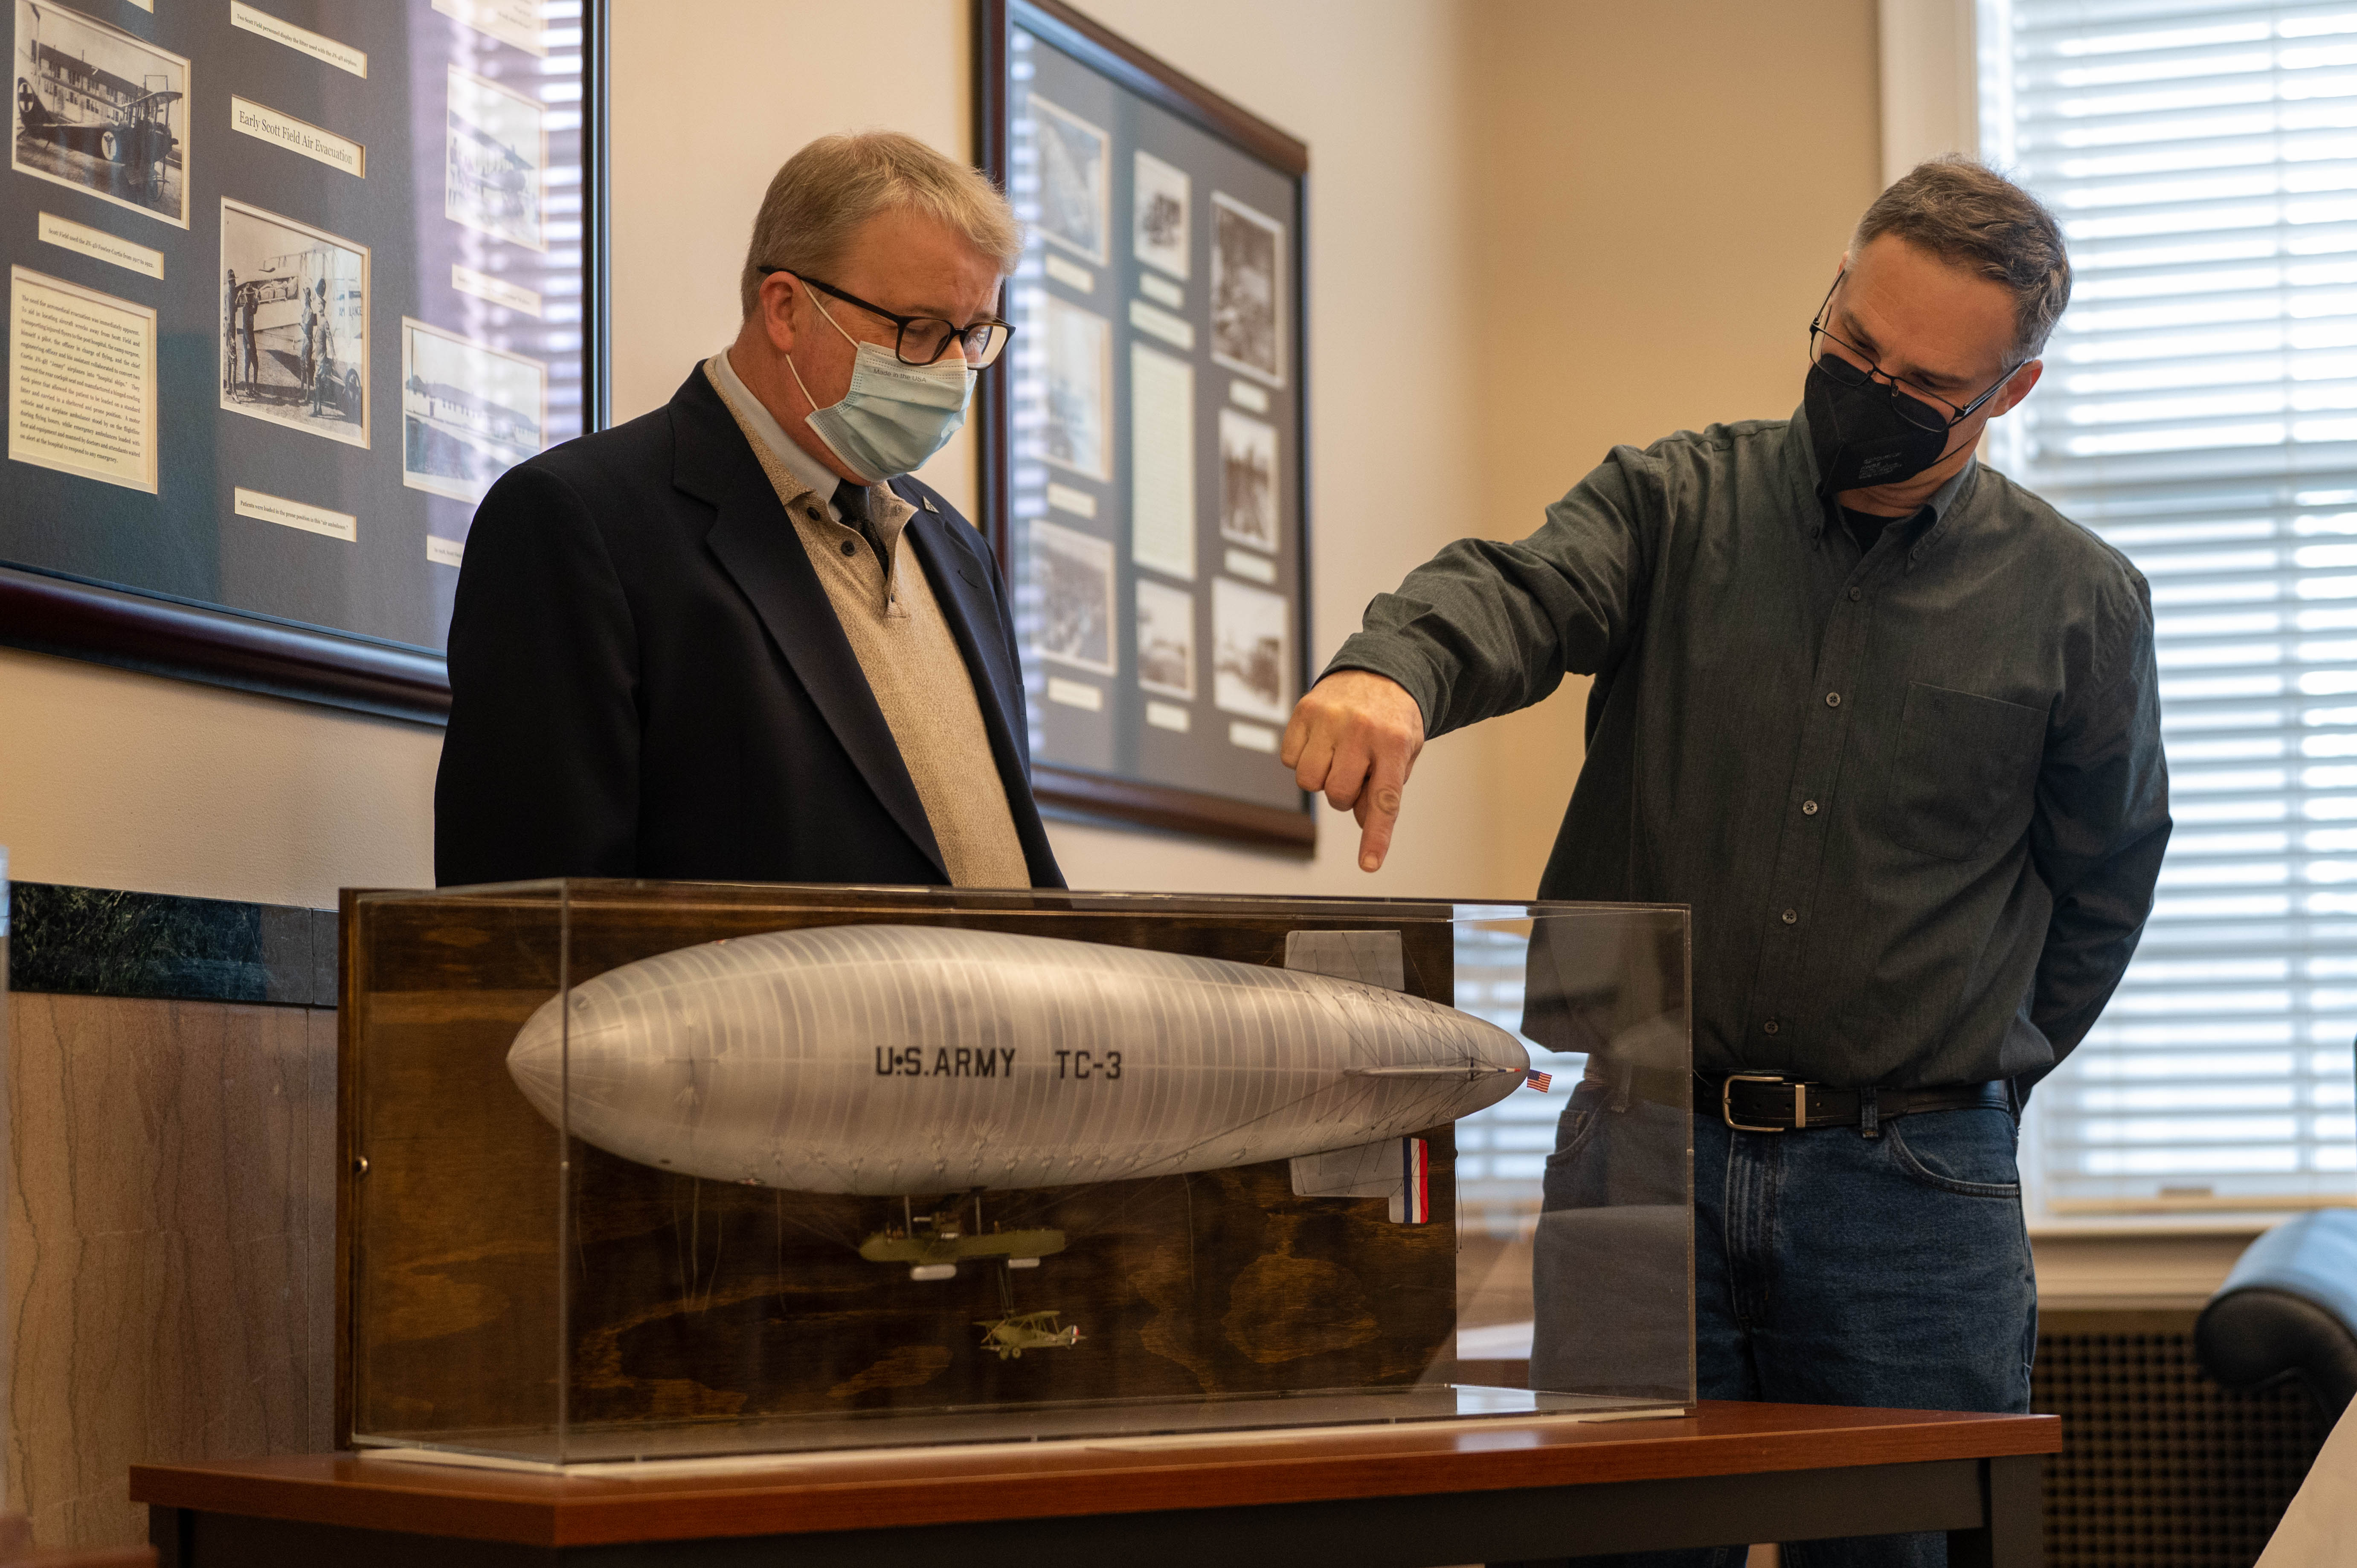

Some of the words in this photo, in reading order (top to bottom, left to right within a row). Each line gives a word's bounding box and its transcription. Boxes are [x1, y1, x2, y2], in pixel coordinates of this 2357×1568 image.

[245, 17, 253, 25] Scott
[254, 20, 262, 29] Field
[263, 25, 280, 36] personnel
[280, 32, 292, 42] display
[299, 39, 308, 47] litter
[309, 43, 317, 51] used
[239, 110, 260, 131] Early
[262, 119, 280, 137] Scott
[282, 127, 300, 144] Field
[302, 135, 313, 149] Air
[315, 139, 352, 165] Evacuation
[48, 228, 58, 236] Scott
[123, 252, 132, 261] from
[339, 306, 362, 317] AMLANCE
[241, 500, 255, 508] Patients
[264, 506, 275, 514] loaded
[1055, 1050, 1122, 1080] TC-3
